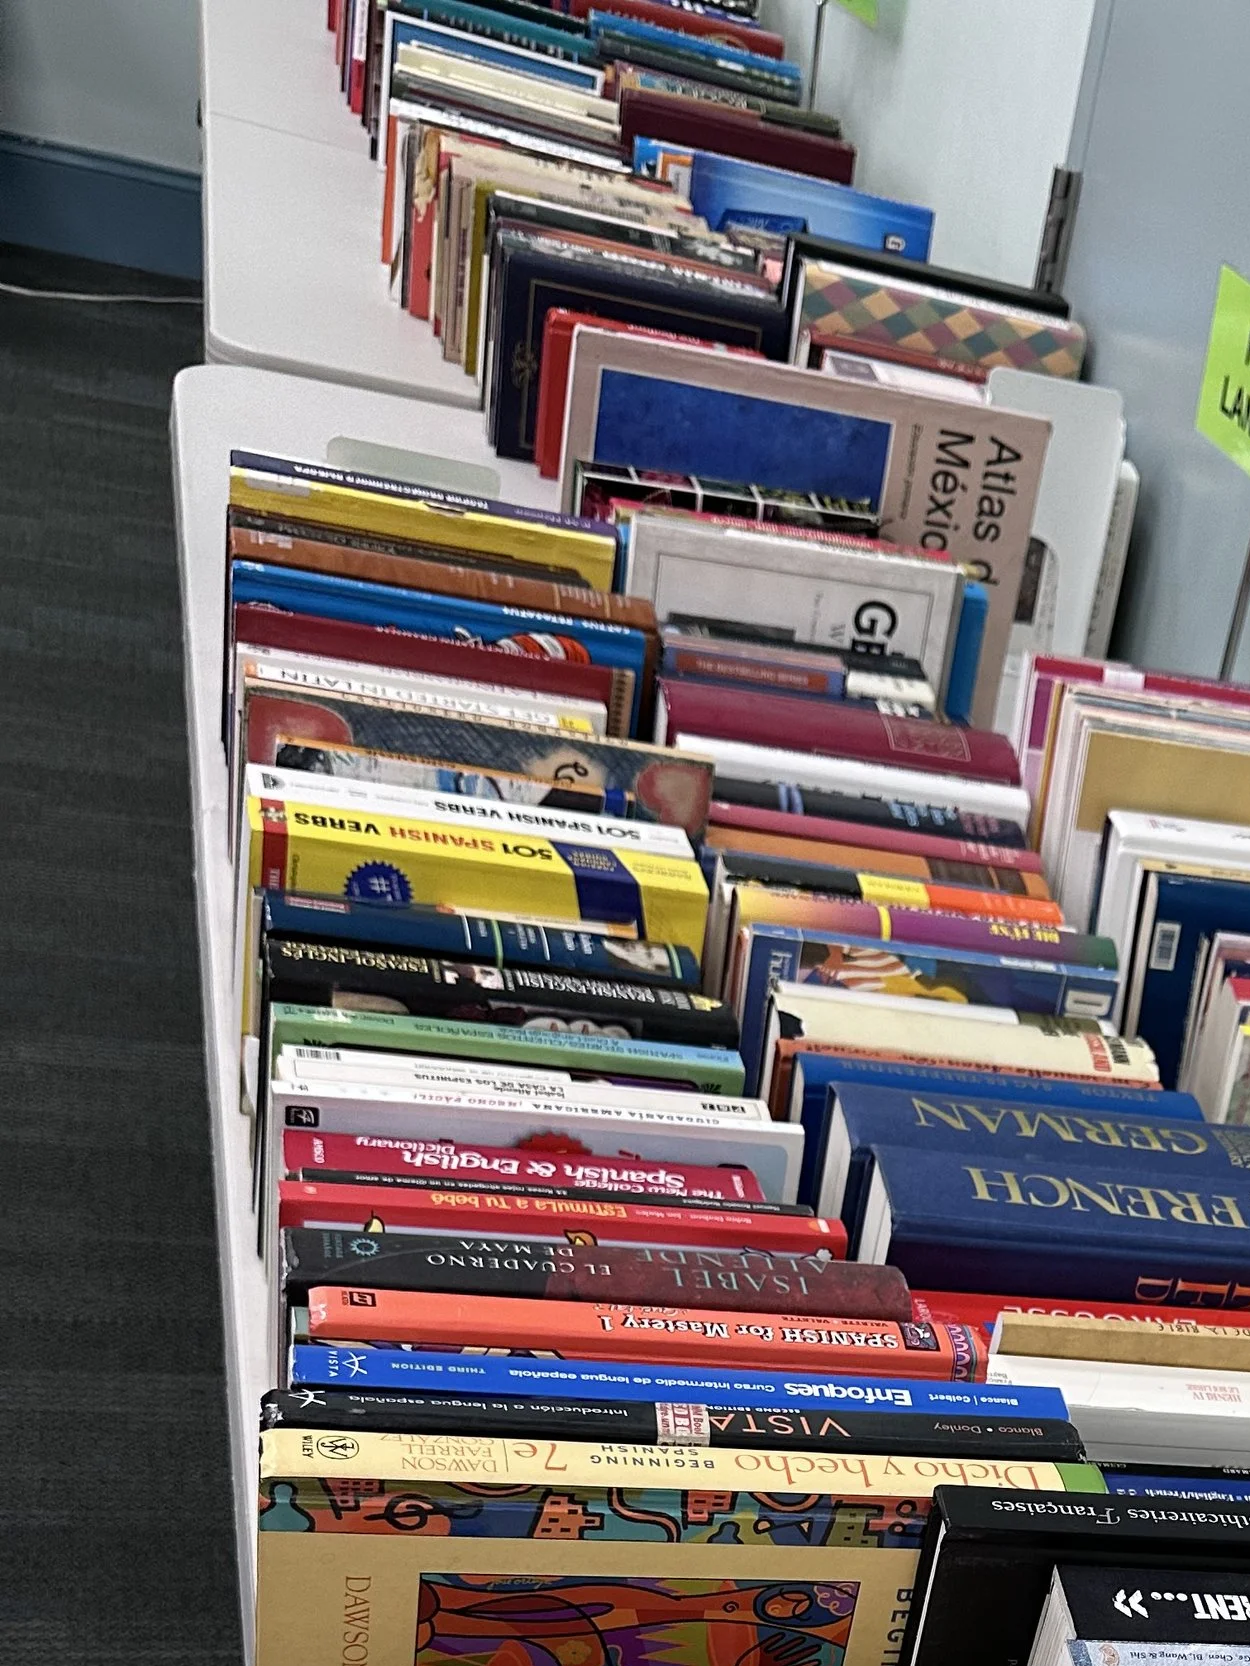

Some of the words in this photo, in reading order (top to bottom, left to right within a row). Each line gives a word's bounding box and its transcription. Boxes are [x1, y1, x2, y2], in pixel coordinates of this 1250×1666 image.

[919, 429, 975, 553] Méxic
[973, 435, 1023, 543] Atlas
[280, 668, 352, 692] LATIN
[433, 801, 503, 821] VERBS
[293, 812, 381, 836] VERBS
[507, 810, 592, 833] SPANISH
[388, 826, 495, 853] SPANISH
[597, 824, 641, 841] 501
[501, 842, 553, 861] 501
[910, 1097, 1210, 1156] GERMAN
[355, 1136, 457, 1155] Dictionary
[400, 1149, 521, 1176] English
[527, 1161, 556, 1180] &
[563, 1163, 686, 1190] Spanish
[574, 1179, 658, 1195] College
[661, 1184, 690, 1197] New
[693, 1187, 725, 1200] The
[458, 1240, 532, 1255] MAYA
[549, 1244, 574, 1258] DE
[426, 1253, 575, 1274] CUADERNO
[583, 1263, 611, 1276] EL
[598, 1315, 613, 1334] 1
[623, 1314, 730, 1339] Mastery
[735, 1323, 780, 1343] for
[782, 1326, 900, 1351] SPANISH
[327, 1349, 340, 1378] VISTA
[509, 1368, 577, 1380] española
[580, 1372, 630, 1383] lengua
[633, 1375, 652, 1384] de
[655, 1378, 730, 1390] intermedio
[734, 1382, 775, 1393] Curso
[783, 1382, 913, 1407] Enfoques
[348, 1394, 425, 1406] española
[430, 1398, 487, 1410] lengua
[491, 1403, 508, 1411] la
[513, 1403, 524, 1411] a
[530, 1404, 628, 1417] Introducción
[709, 1413, 852, 1437] VISTA
[302, 1434, 313, 1459] WILEY
[513, 1441, 568, 1472] 7e
[733, 1454, 872, 1488] hecho
[882, 1456, 906, 1477] y
[912, 1461, 1041, 1491] Dicho
[990, 1499, 1121, 1527] Françaises
